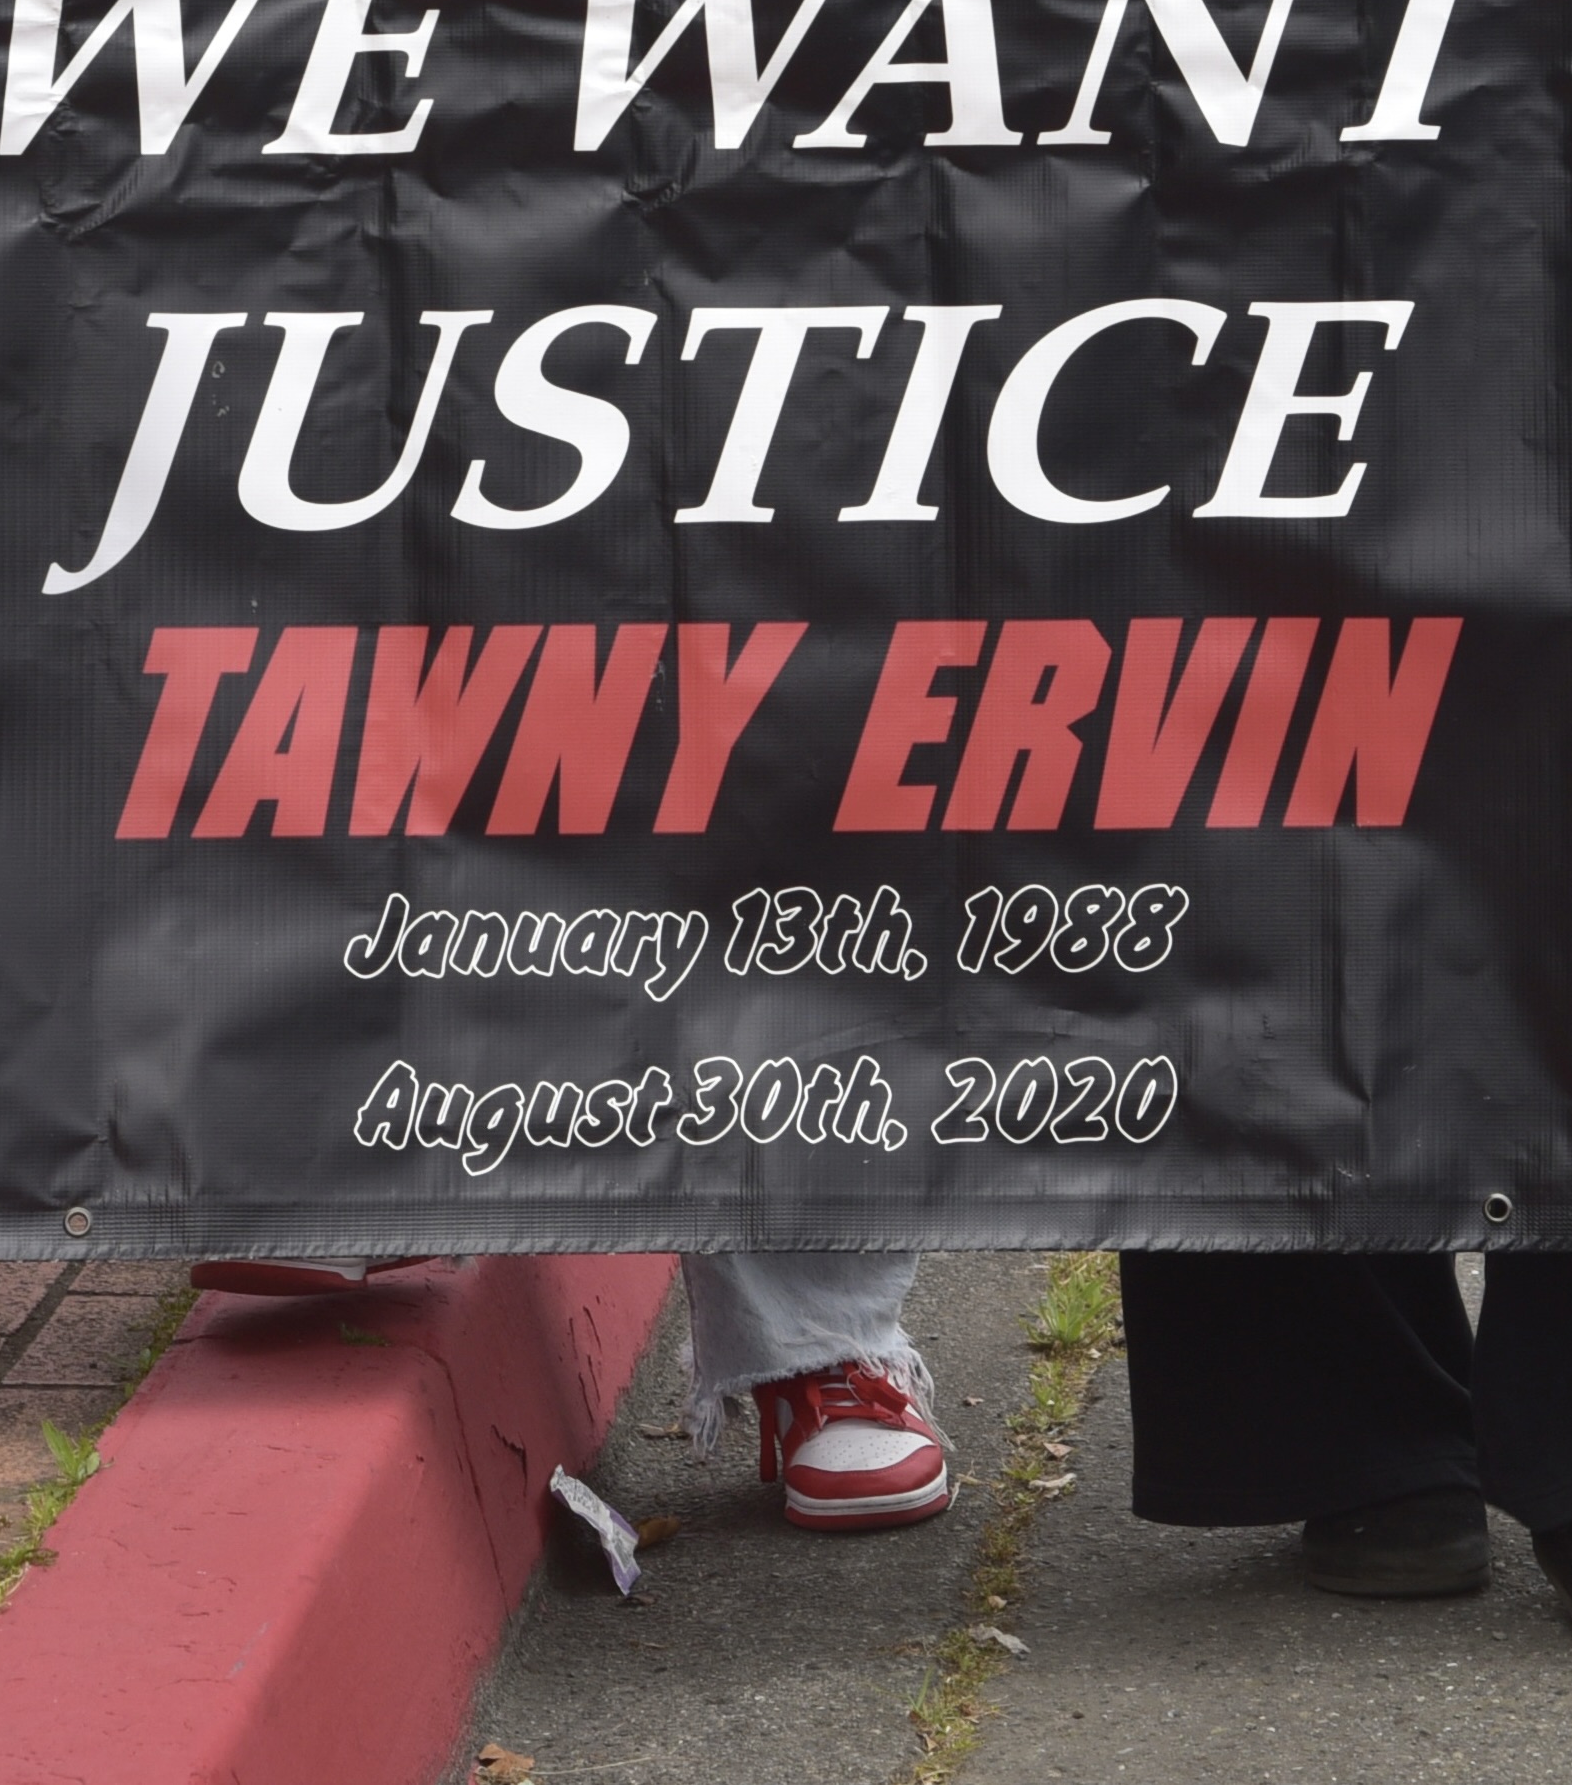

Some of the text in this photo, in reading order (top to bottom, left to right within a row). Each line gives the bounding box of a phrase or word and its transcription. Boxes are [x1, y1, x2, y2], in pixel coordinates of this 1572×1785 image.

[41, 298, 1416, 595] JUSTICE
[116, 616, 1464, 840] TAWNY ERVIN
[343, 883, 1190, 1003] January 13th, 1988
[353, 1054, 1178, 1177] August 30th, 2020
